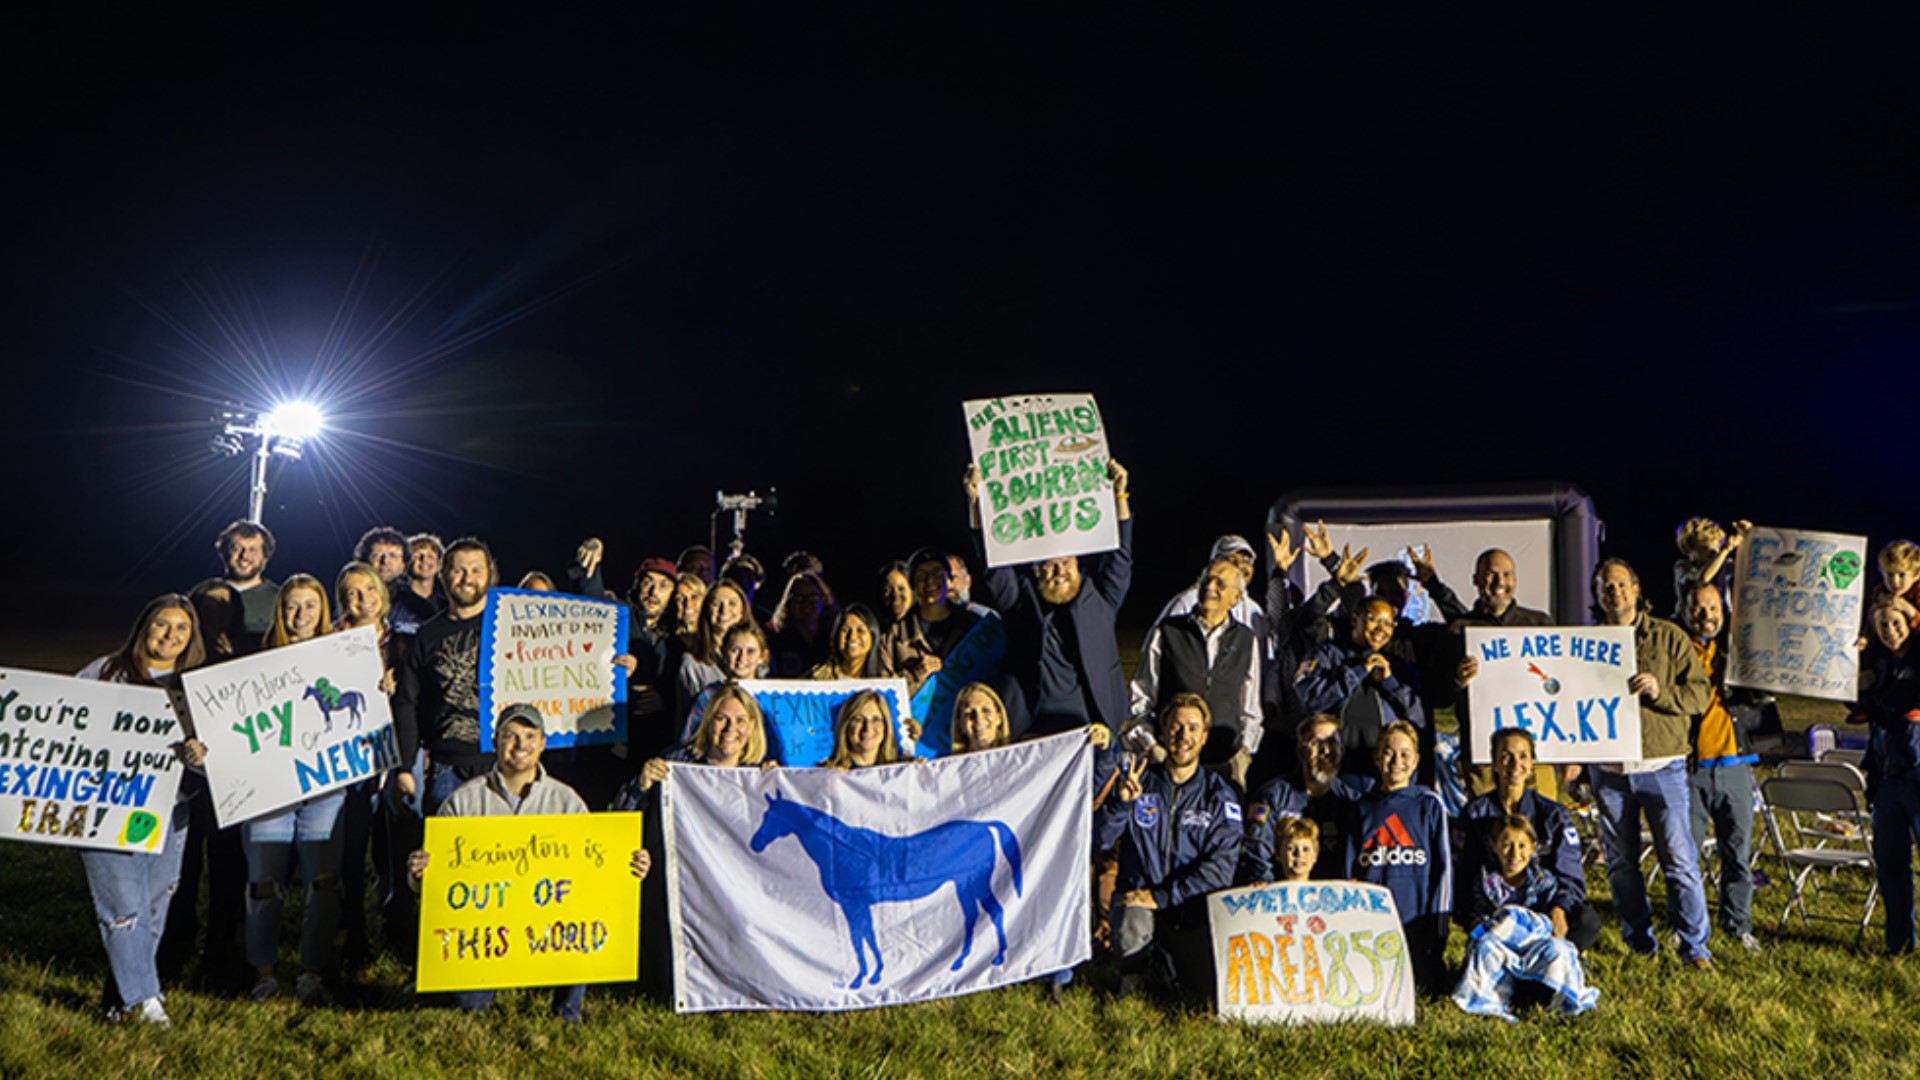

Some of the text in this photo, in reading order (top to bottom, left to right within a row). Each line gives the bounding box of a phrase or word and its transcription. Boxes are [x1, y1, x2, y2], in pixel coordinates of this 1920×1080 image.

[970, 399, 1006, 431] HEY
[988, 400, 1100, 448] ALIENS!
[979, 440, 1050, 480] FIRST
[992, 497, 1101, 544] ON US
[510, 602, 610, 621] LEXINGTON
[1739, 584, 1857, 625] PHONE
[511, 620, 604, 639] INVADED MY
[1481, 634, 1622, 667] WE ARE HERE
[1740, 623, 1857, 677] LEX
[504, 661, 600, 692] ALIENS,
[112, 710, 176, 735] now
[0, 728, 178, 785] ntering your
[0, 763, 155, 807] EXINGTON
[17, 799, 109, 838] ERA!
[448, 834, 606, 876] Lexington is
[447, 878, 572, 910] OUT OF
[1221, 885, 1391, 915] WELCOME
[433, 920, 608, 961] THIS WORLD
[1275, 914, 1326, 934] TO
[1225, 930, 1405, 1010] AREA 859
